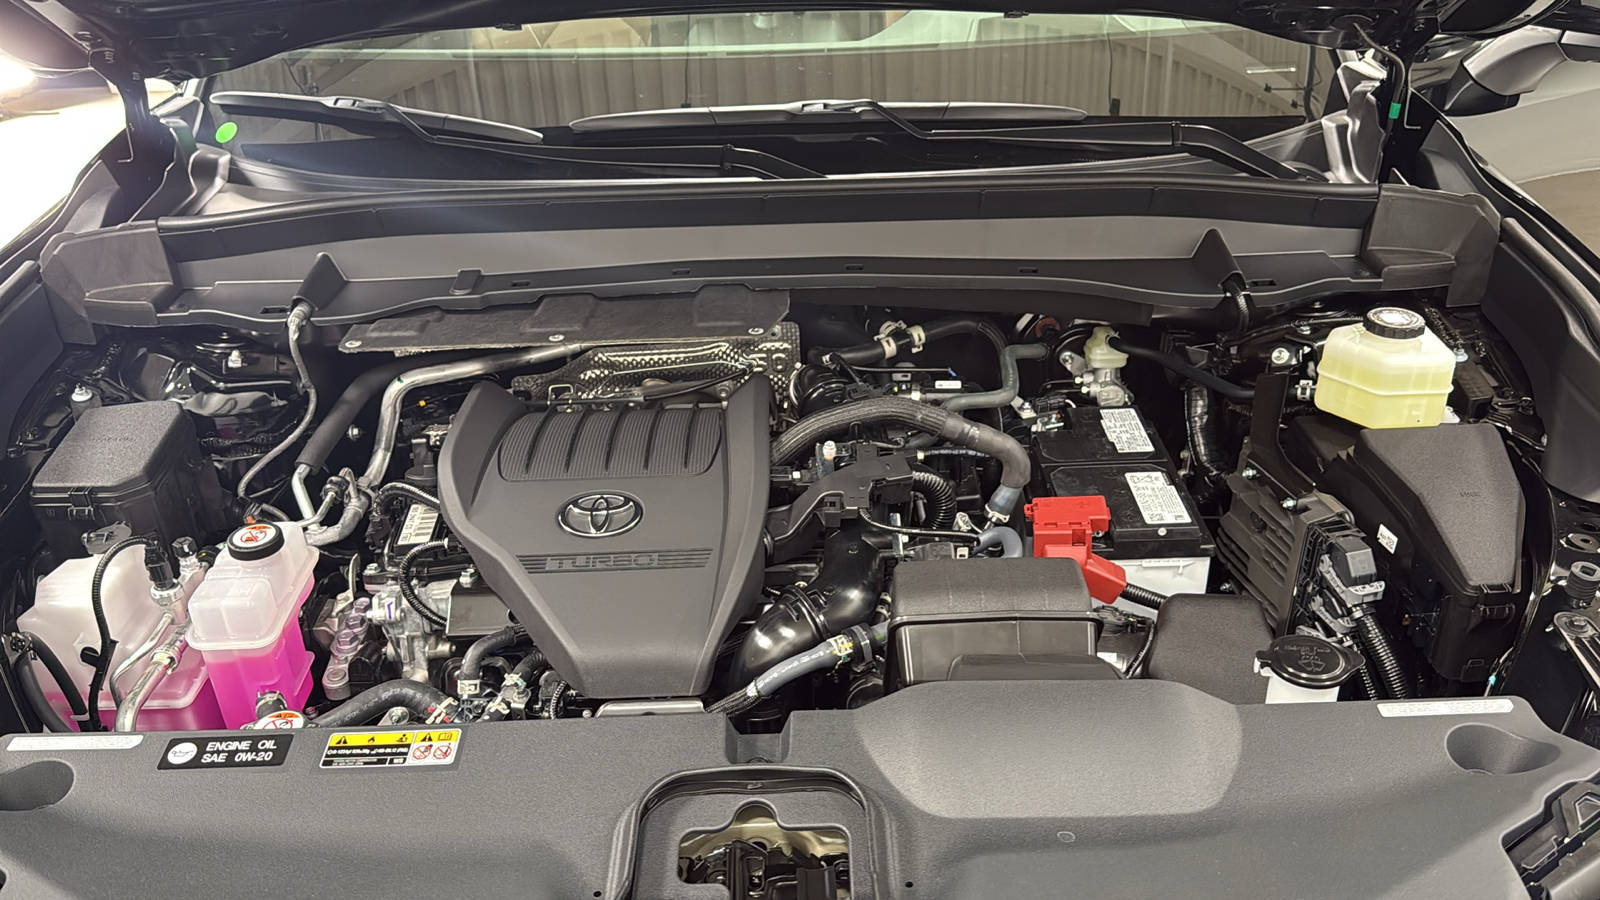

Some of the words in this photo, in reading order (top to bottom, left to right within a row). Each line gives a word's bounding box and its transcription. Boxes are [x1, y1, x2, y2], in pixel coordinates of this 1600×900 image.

[549, 554, 655, 569] TURBO
[206, 740, 252, 752] ENGINE
[257, 739, 277, 750] OIL
[201, 753, 228, 763] SAE
[234, 751, 273, 762] 0W-20
